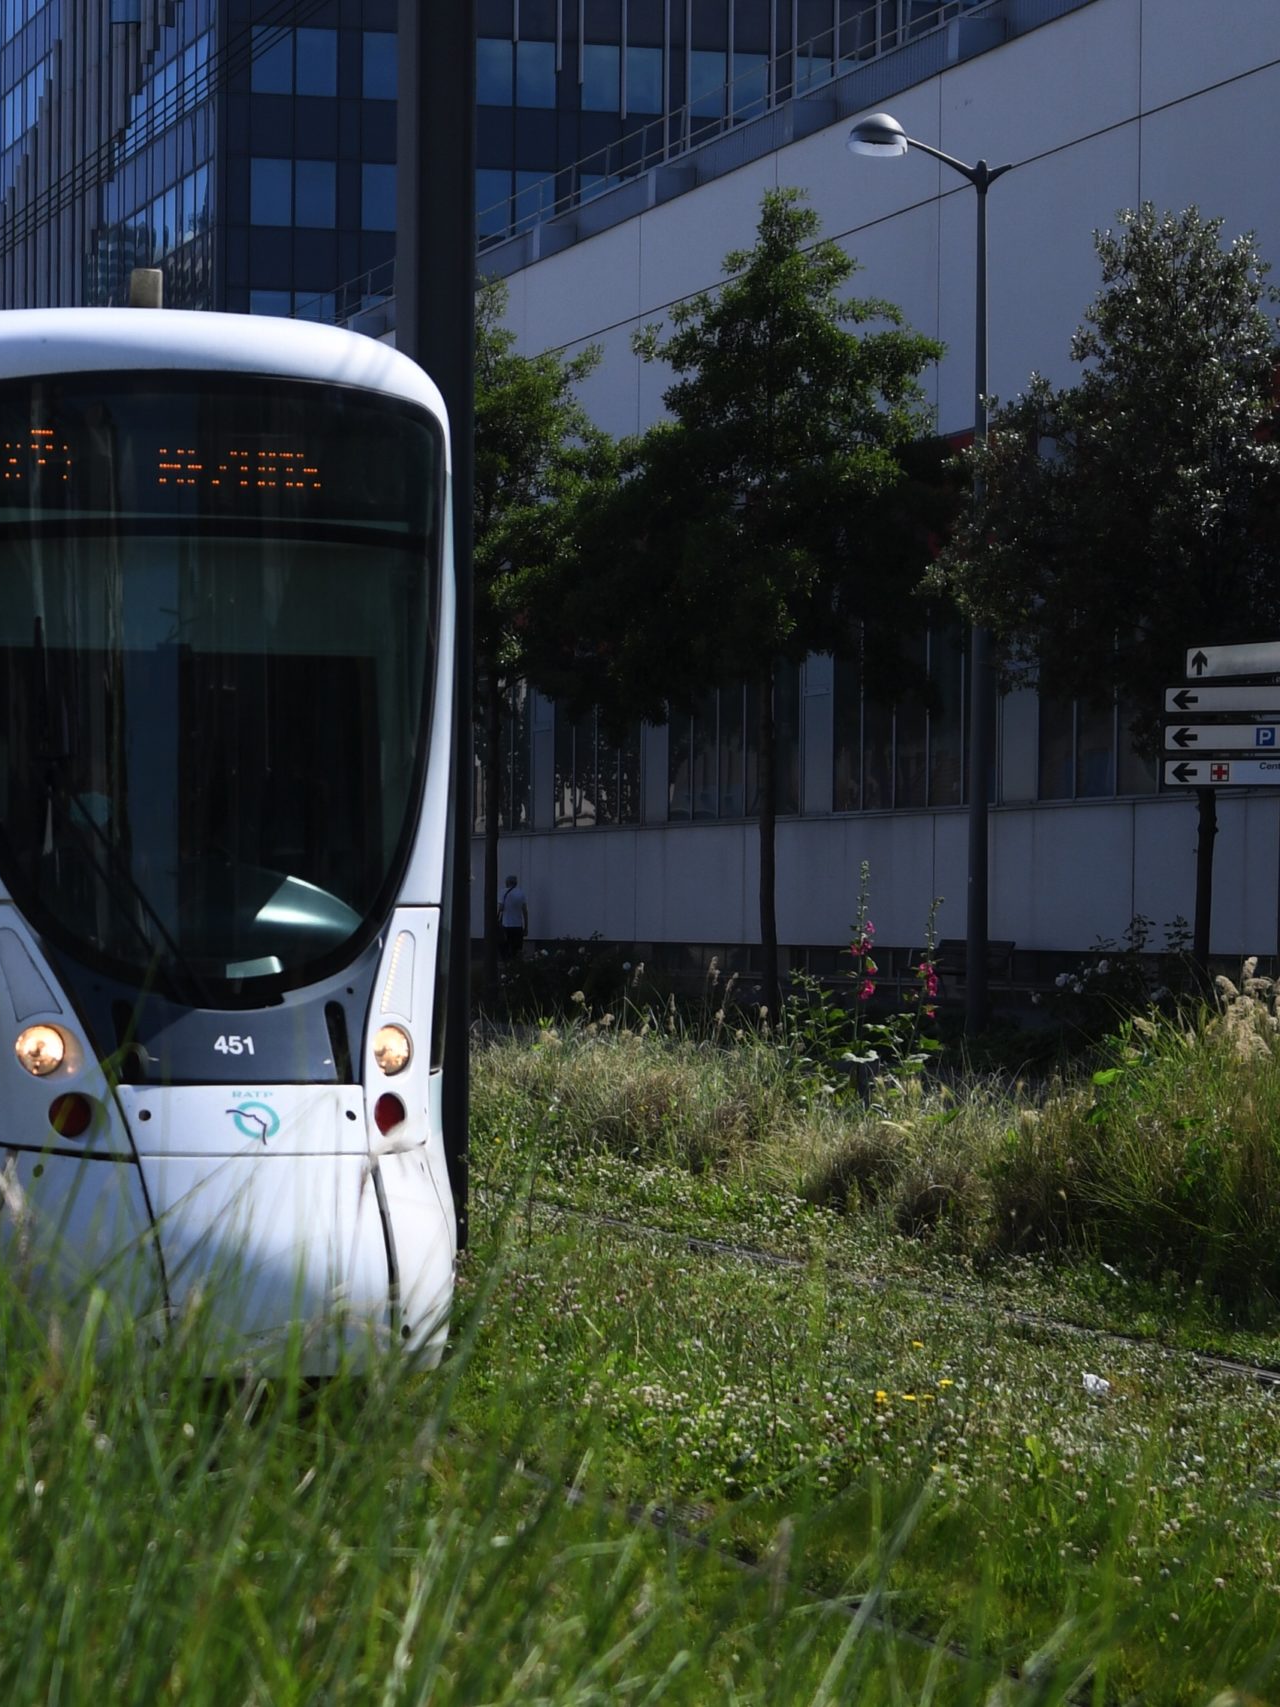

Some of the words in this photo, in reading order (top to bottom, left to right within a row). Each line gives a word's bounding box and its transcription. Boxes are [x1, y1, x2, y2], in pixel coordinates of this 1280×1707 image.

[1259, 729, 1272, 745] P
[214, 1035, 255, 1055] 451
[232, 1090, 273, 1098] RATP
